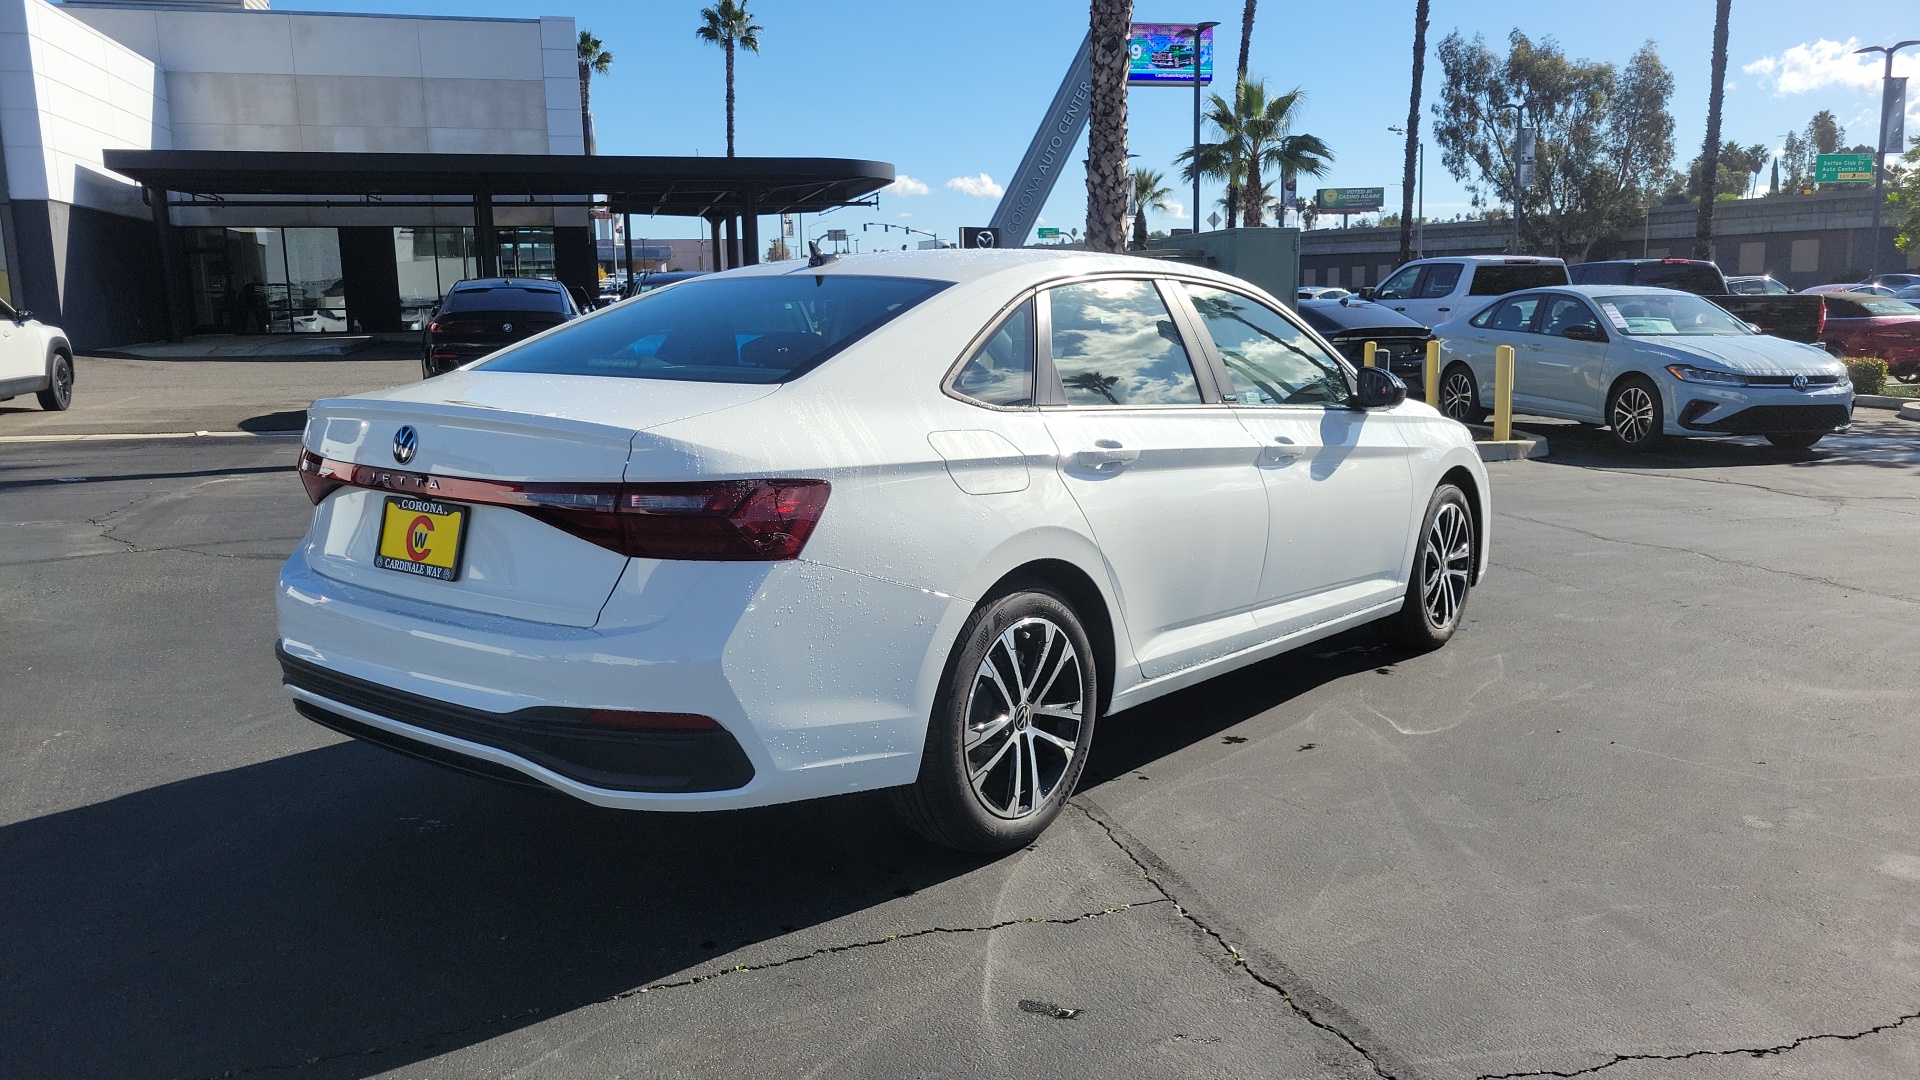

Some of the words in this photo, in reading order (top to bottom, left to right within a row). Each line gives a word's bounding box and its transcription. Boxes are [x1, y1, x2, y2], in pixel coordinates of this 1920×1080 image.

[1130, 44, 1142, 60] 9
[1006, 176, 1044, 234] CORONA
[1038, 135, 1063, 176] AUTO
[1058, 81, 1092, 135] CENTER
[371, 472, 440, 491] JETTA
[401, 499, 444, 515] CORONA
[384, 558, 425, 575] CARDINALE
[426, 567, 443, 578] WAY
